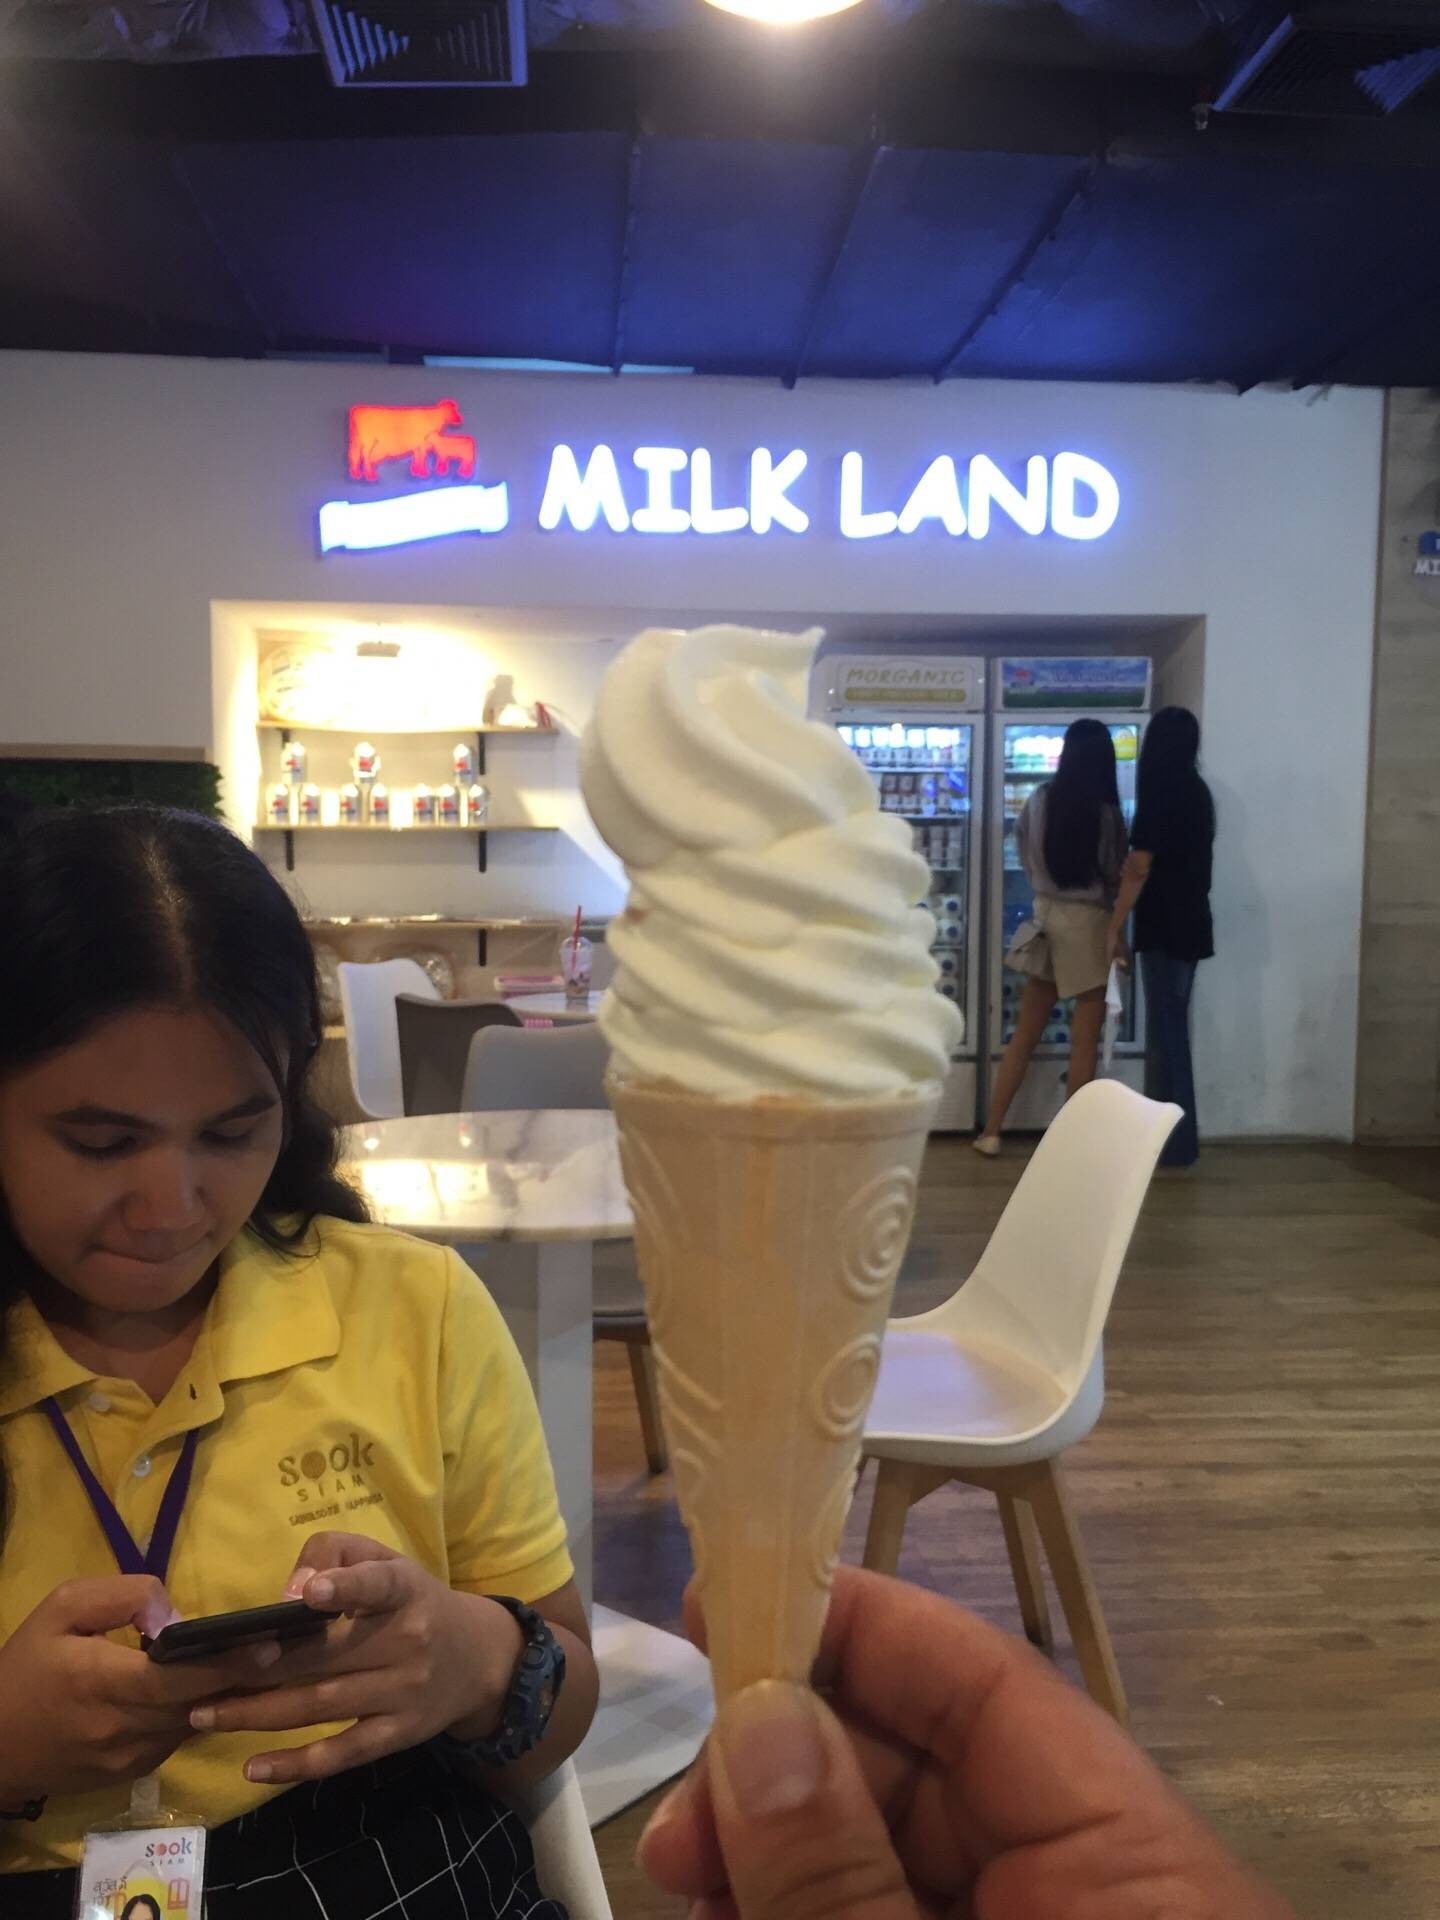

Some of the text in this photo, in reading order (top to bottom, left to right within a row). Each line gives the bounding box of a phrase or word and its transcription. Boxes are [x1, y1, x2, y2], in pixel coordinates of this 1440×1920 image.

[538, 443, 1122, 540] MILK LAND
[846, 668, 966, 685] MORGANIC
[297, 1474, 365, 1502] SIAM
